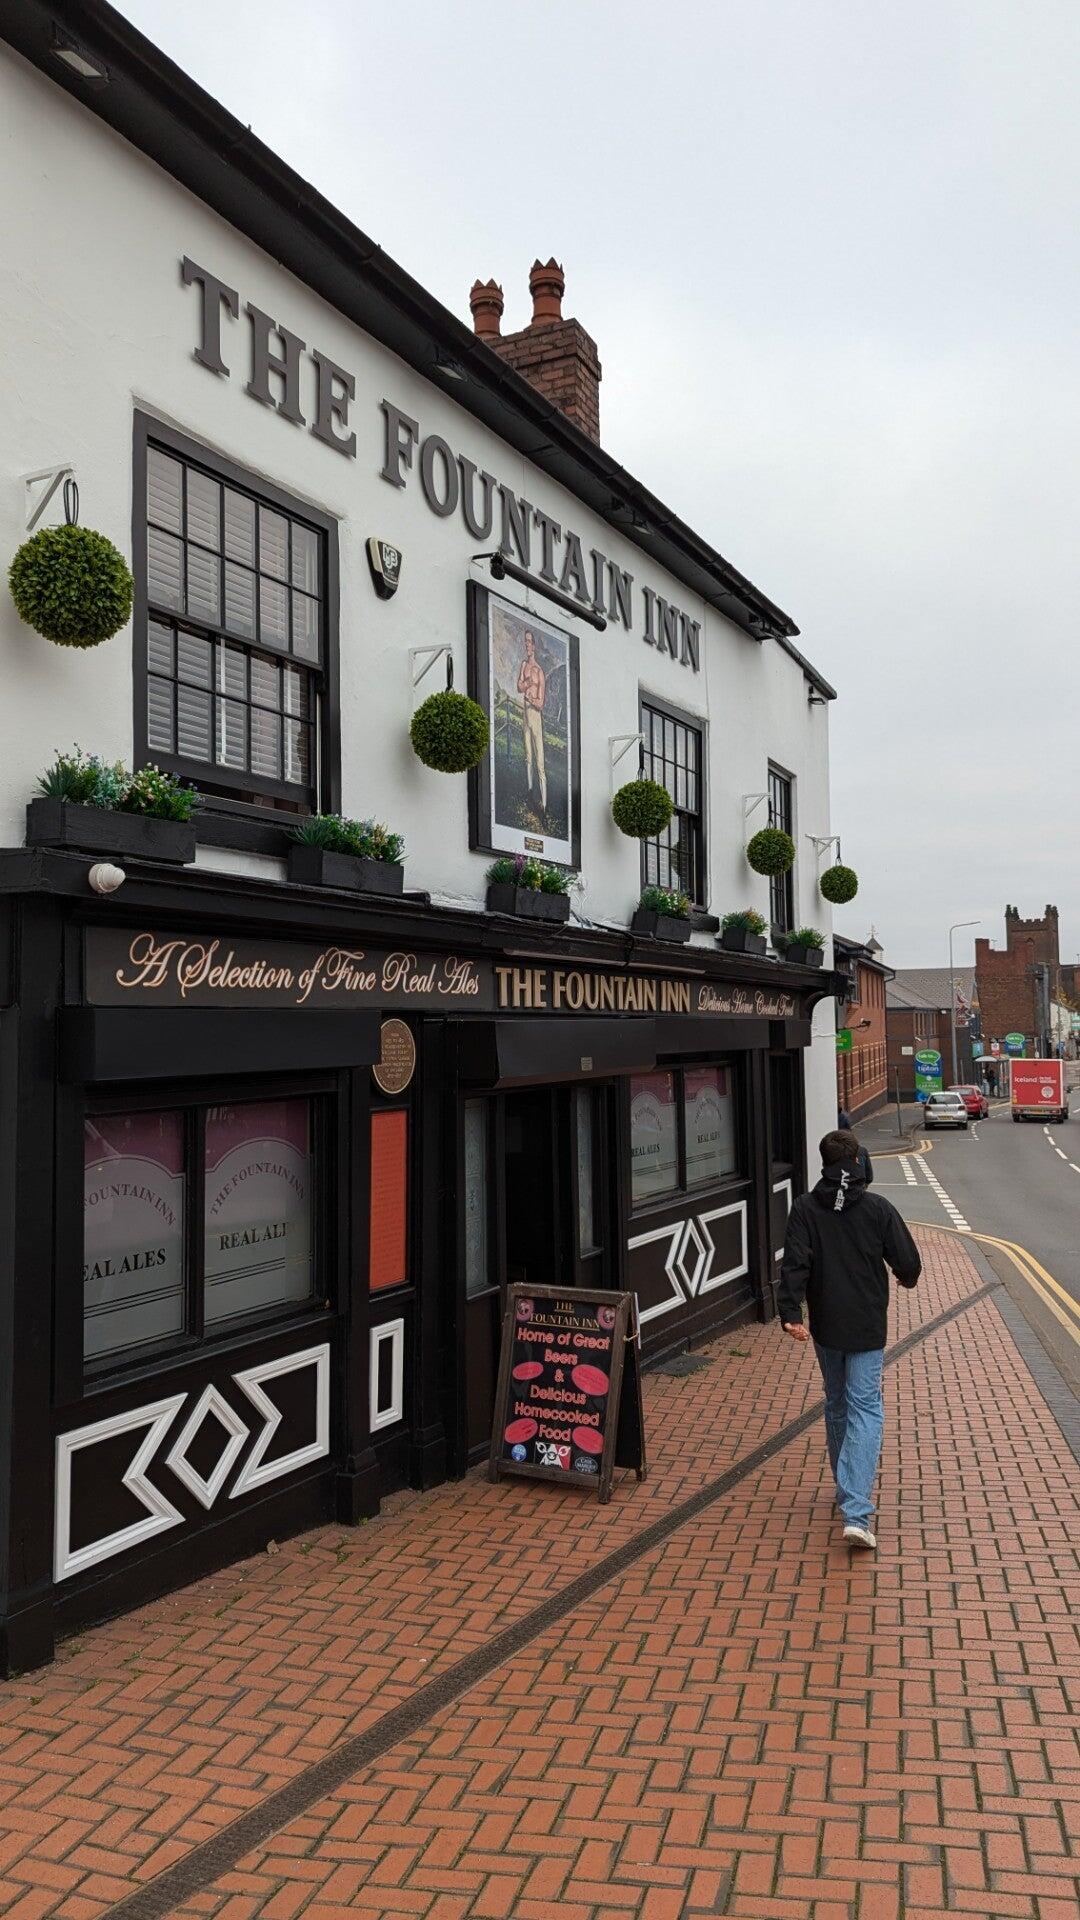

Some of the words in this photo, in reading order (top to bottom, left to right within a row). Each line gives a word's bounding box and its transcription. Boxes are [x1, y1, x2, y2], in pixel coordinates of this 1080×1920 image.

[183, 255, 356, 458] THE
[380, 398, 634, 630] FOUNTAIN
[642, 585, 701, 672] INN
[116, 933, 187, 988] A
[177, 939, 294, 998] Selection
[296, 954, 325, 1003] of
[321, 947, 377, 991] Fine
[381, 952, 436, 993] Real
[437, 956, 480, 995] Ales
[496, 967, 547, 1009] THE
[553, 971, 657, 1012] FOUNTAIN
[660, 980, 691, 1013] INN
[731, 988, 753, 1014] Home
[210, 1183, 233, 1215] THE
[231, 1162, 290, 1187] FOUNTAIN
[288, 1174, 305, 1201] INN
[154, 1198, 176, 1226] INN
[219, 1228, 260, 1251] REAL
[82, 1260, 115, 1282] EAL
[119, 1248, 167, 1274] ALES
[556, 1301, 574, 1310] THE
[530, 1313, 579, 1327] FOUNTAIN
[582, 1318, 600, 1329] INN
[517, 1327, 554, 1343] Home
[557, 1332, 571, 1345] of
[573, 1333, 611, 1350] Great
[544, 1349, 578, 1366] Beers
[554, 1368, 565, 1383] &
[530, 1384, 587, 1405] Delicious
[514, 1402, 600, 1427] Homecooked
[539, 1424, 571, 1441] Food
